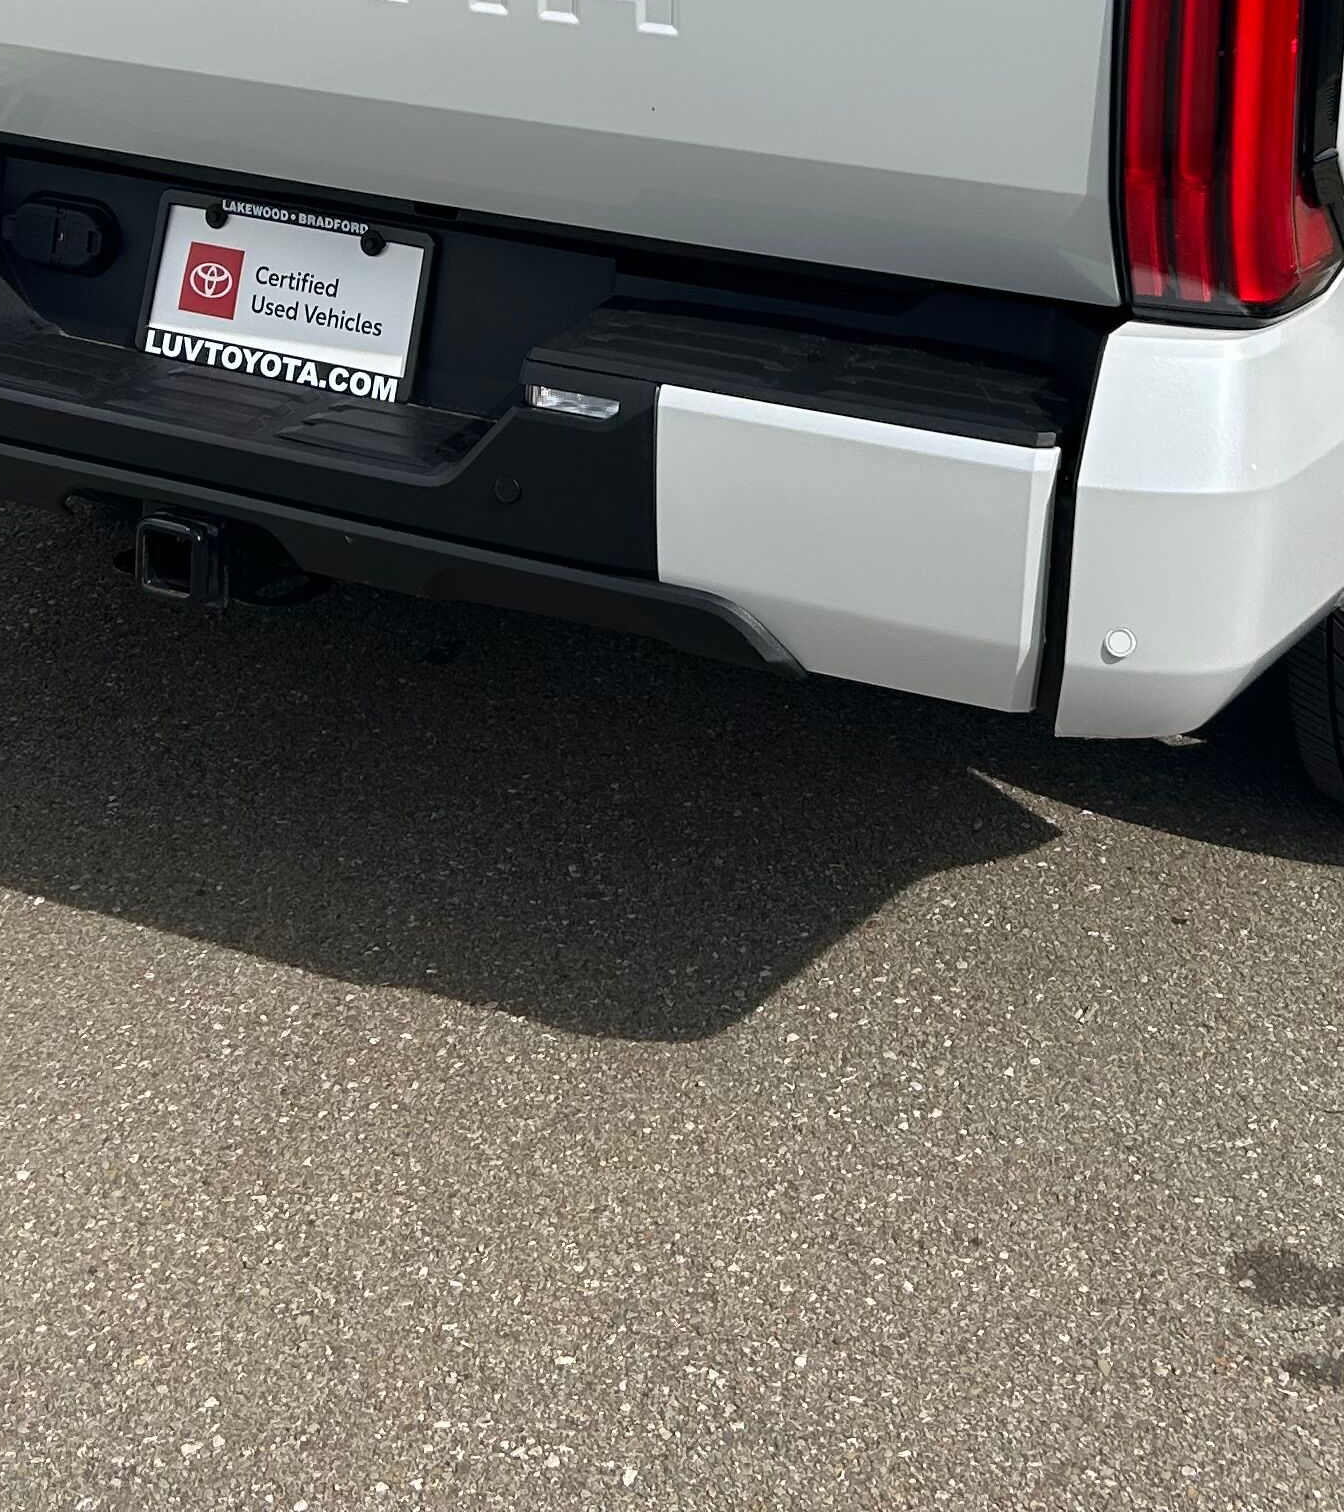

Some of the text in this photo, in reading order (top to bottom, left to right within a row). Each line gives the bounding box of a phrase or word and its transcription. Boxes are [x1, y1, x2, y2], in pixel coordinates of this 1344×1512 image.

[222, 199, 369, 235] LAKEWOOD BRADFORD
[255, 266, 339, 298] Certified
[251, 294, 383, 337] Used Vehicles
[144, 330, 398, 403] LUVTOYOTA.COM
